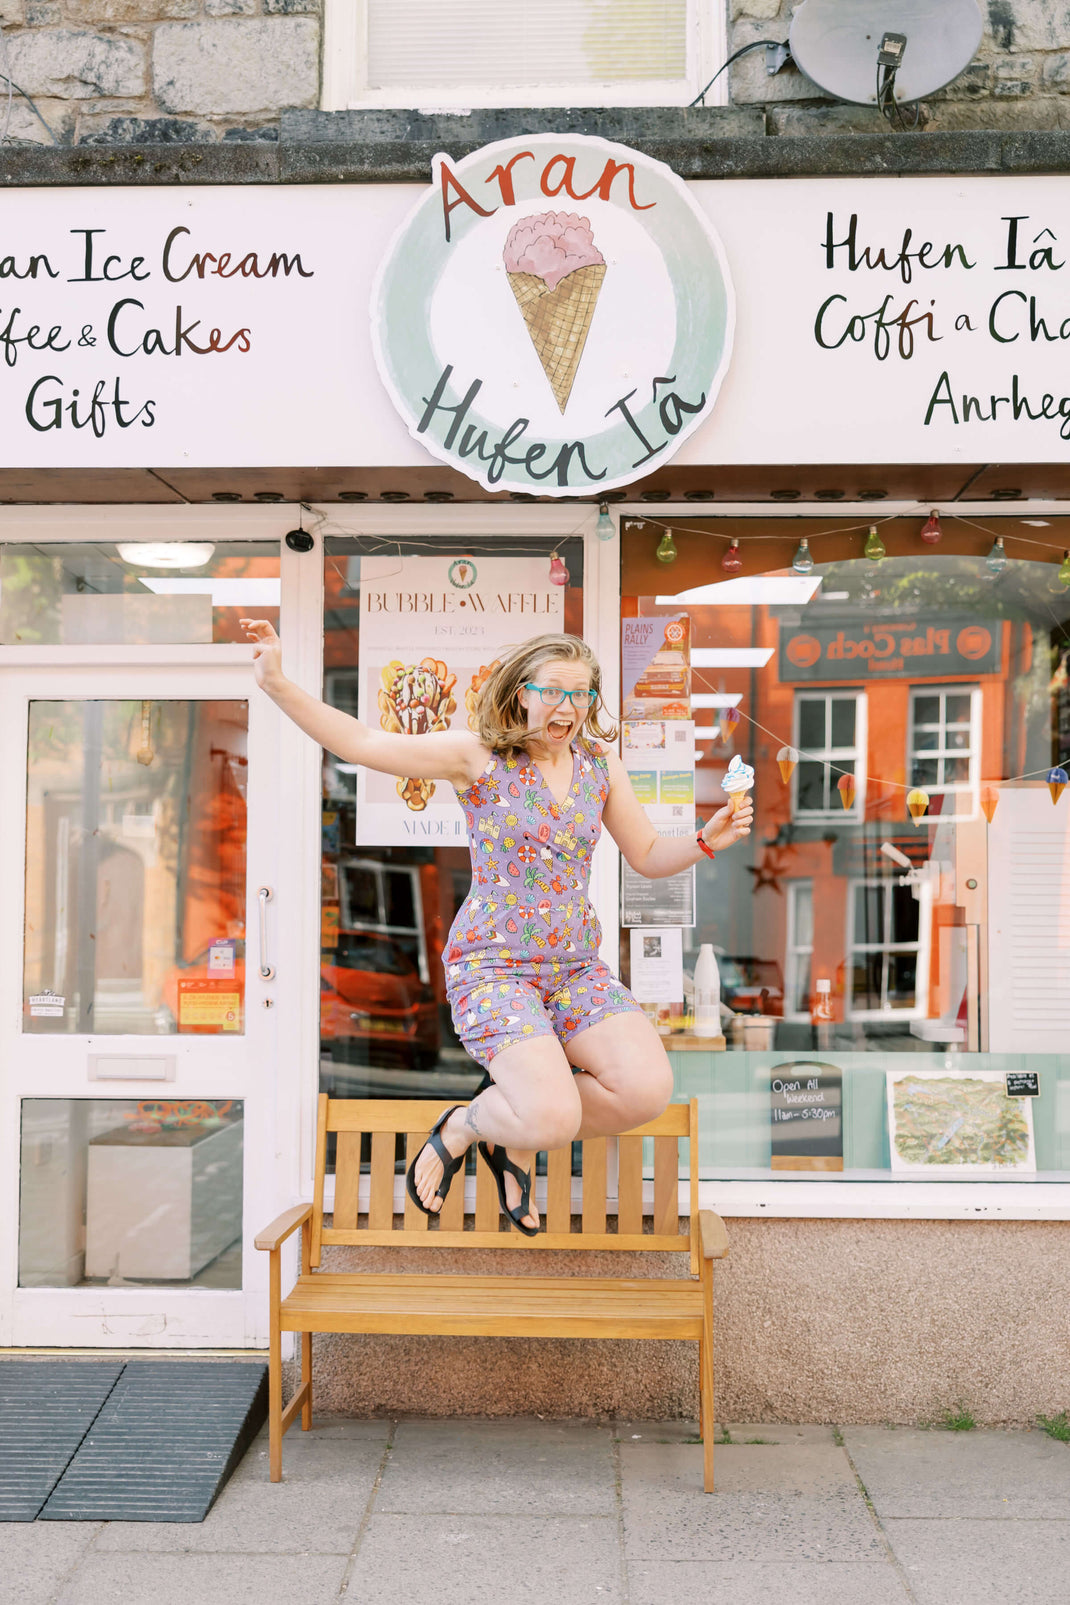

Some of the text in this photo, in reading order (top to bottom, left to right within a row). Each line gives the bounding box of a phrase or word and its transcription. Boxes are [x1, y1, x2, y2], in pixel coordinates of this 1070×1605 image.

[440, 151, 656, 242] Aran
[67, 228, 151, 283] Ice
[162, 225, 315, 283] Cream
[820, 211, 1067, 285] Hufen Iâ
[0, 297, 251, 367] fee & Cakes
[814, 293, 945, 361] Coffi
[954, 314, 979, 331] a
[25, 374, 156, 439] Gifts
[416, 364, 608, 487] Hufen
[367, 592, 559, 614] BUBBLE WAFFLE
[625, 623, 654, 635] PLAINS
[624, 634, 648, 645] RALLY
[403, 820, 450, 835] MADE
[772, 1078, 819, 1098] Open All
[786, 1092, 824, 1104] Weekend
